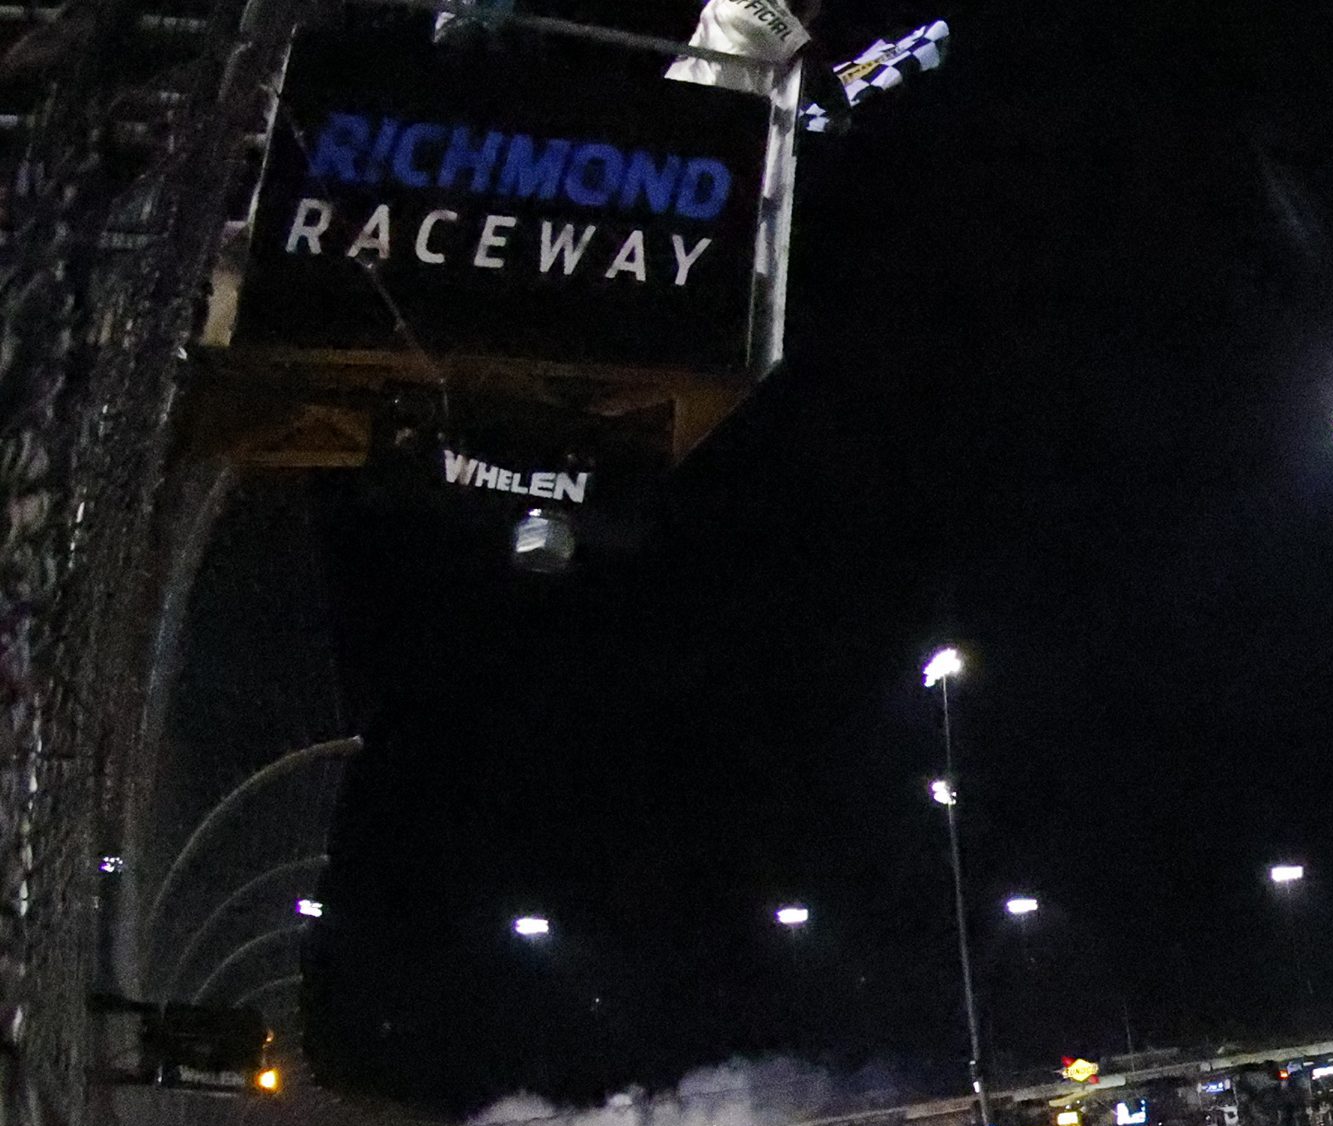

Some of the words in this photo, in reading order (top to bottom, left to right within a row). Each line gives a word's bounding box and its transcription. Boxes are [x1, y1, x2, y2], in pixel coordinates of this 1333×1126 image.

[309, 112, 732, 220] RICHMOND
[286, 198, 711, 286] RACEWAY
[444, 449, 590, 502] WHELEN
